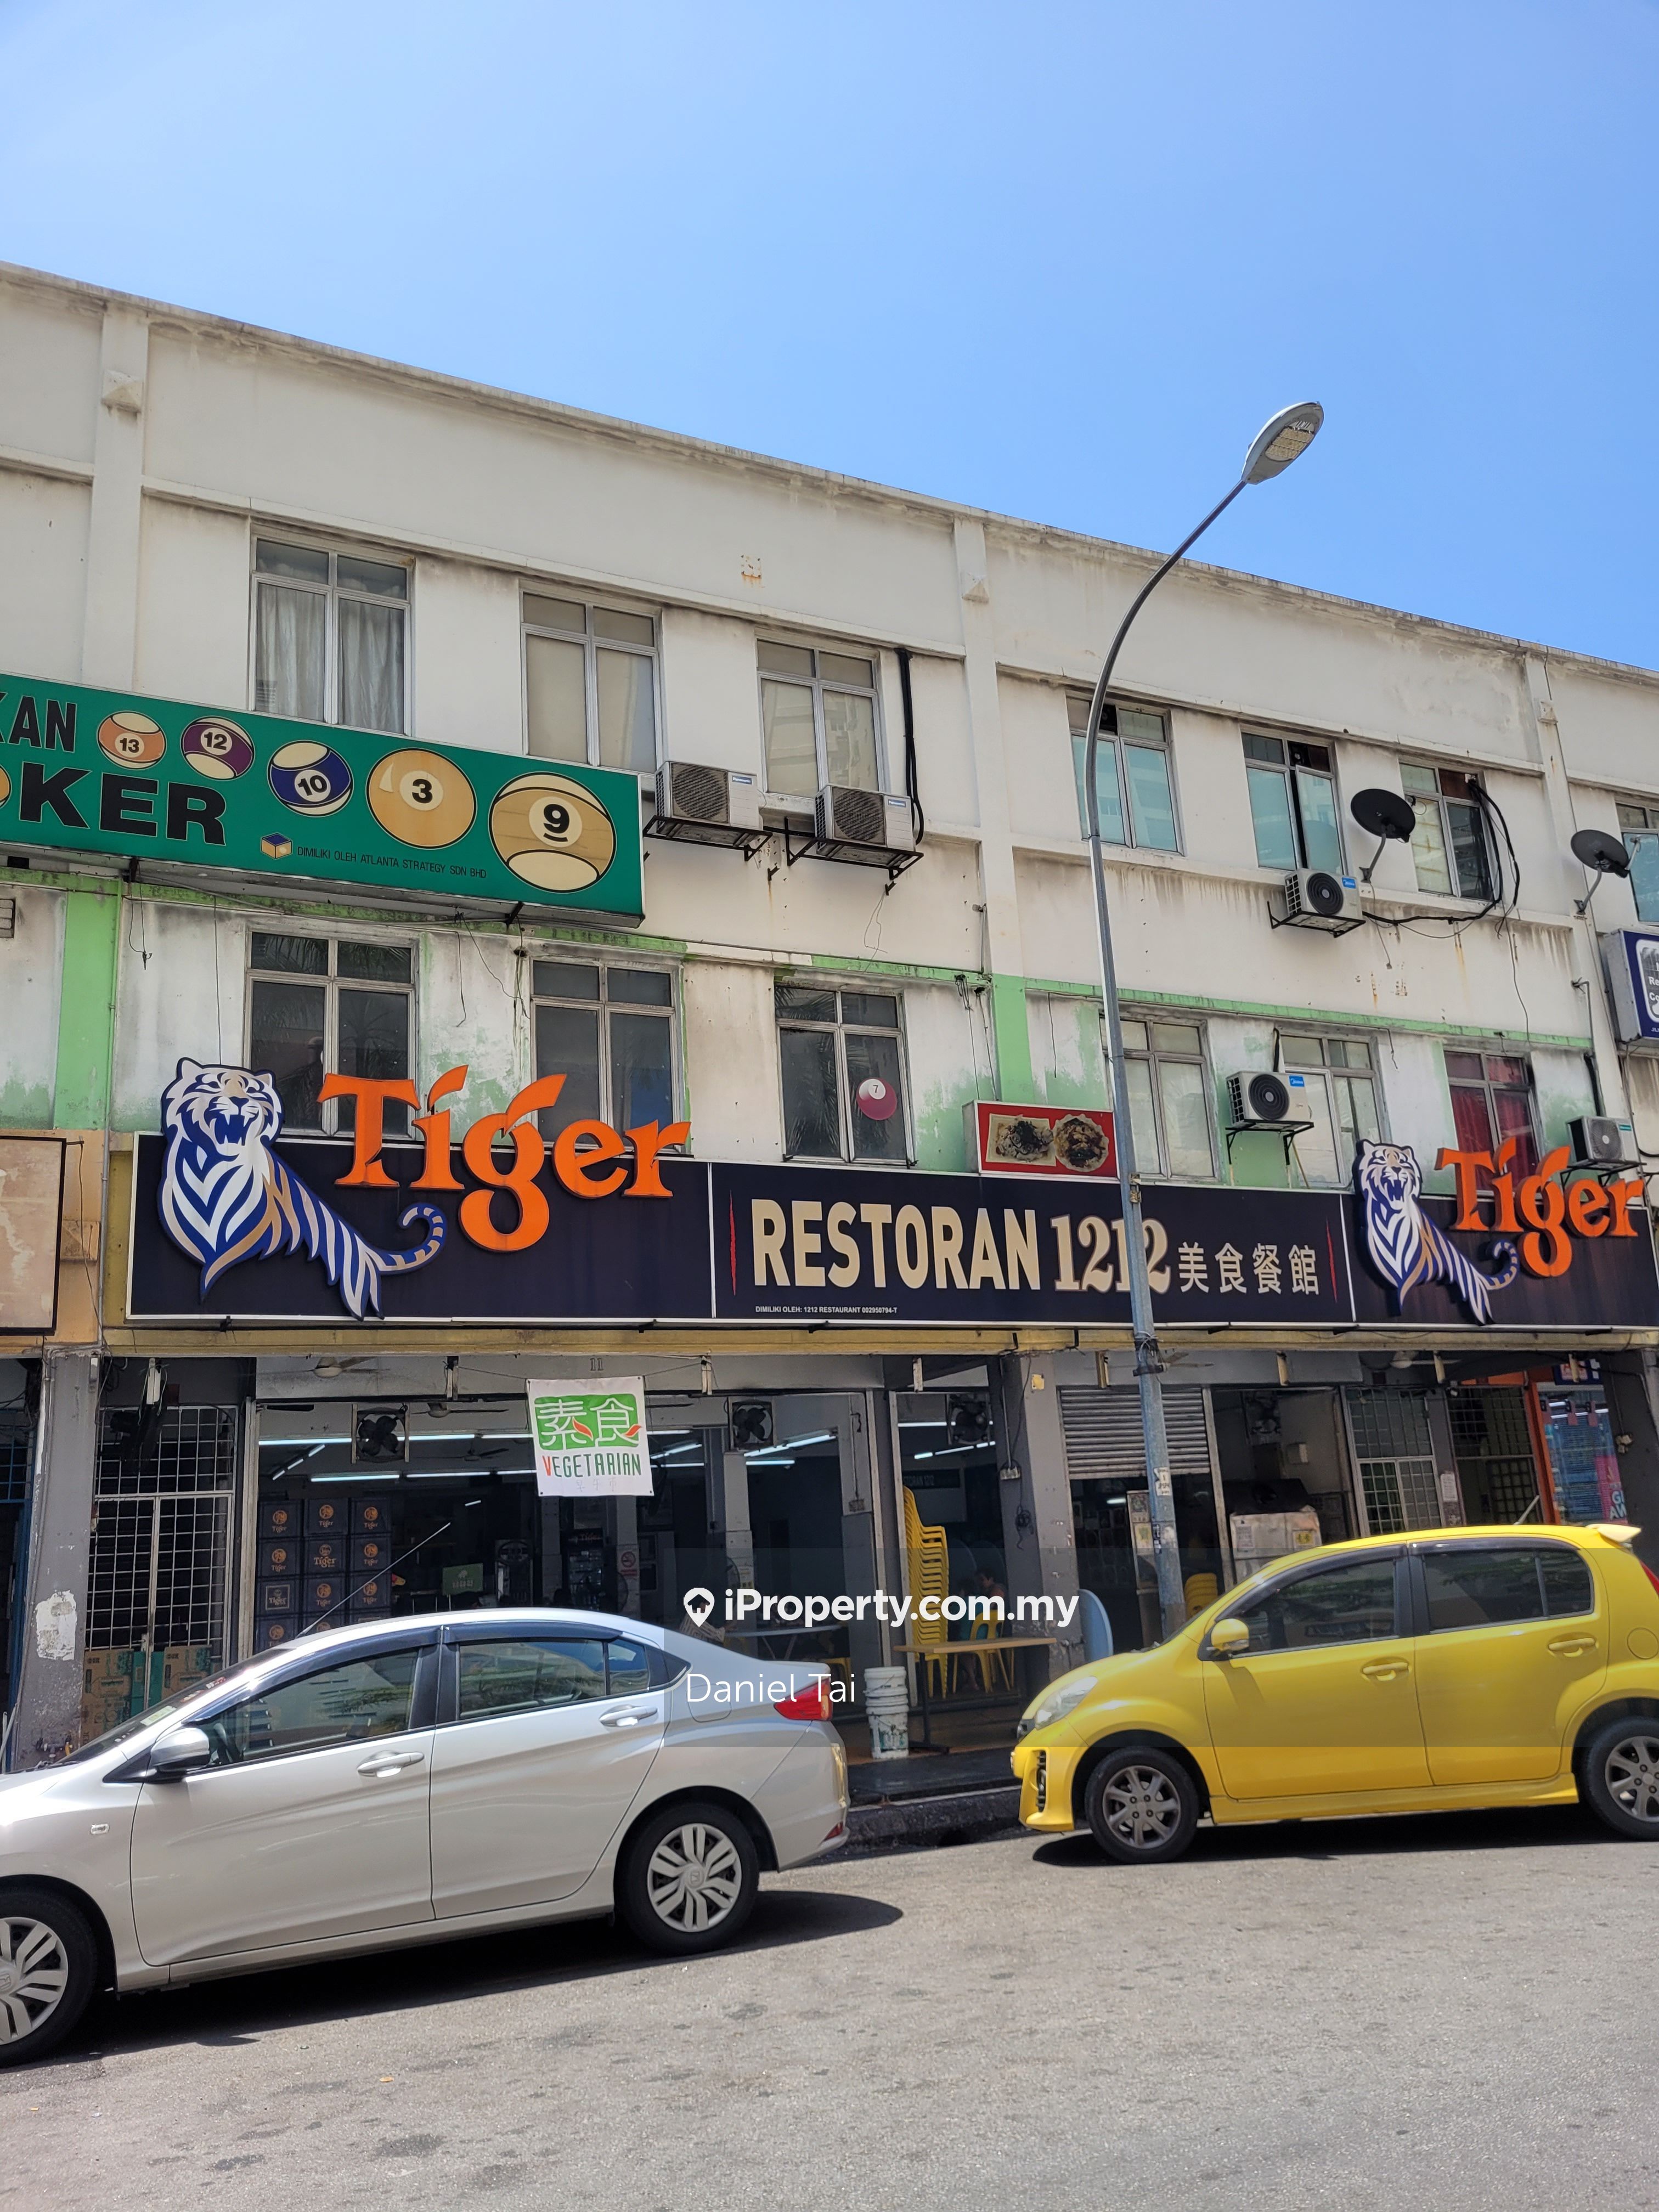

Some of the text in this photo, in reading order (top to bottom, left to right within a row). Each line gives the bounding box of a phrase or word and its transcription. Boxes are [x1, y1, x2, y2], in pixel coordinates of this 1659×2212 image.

[119, 737, 140, 753] 13
[204, 732, 228, 751] 12
[297, 775, 328, 797] 10
[411, 778, 432, 804] 3
[0, 761, 226, 846] KER
[543, 804, 570, 834] 9
[297, 847, 487, 878] DIMILIKI OLEH ATLANTA STRATEGY SDN BHD
[317, 1065, 691, 1252] Tiger
[1434, 1137, 1644, 1277] Tiger
[752, 1199, 1171, 1295] RESTORAN 1212
[1178, 1242, 1319, 1295] 美食餐館
[535, 1398, 639, 1449] 素食
[542, 1453, 642, 1477] VEGETARIAN
[314, 1556, 336, 1567] Tiger
